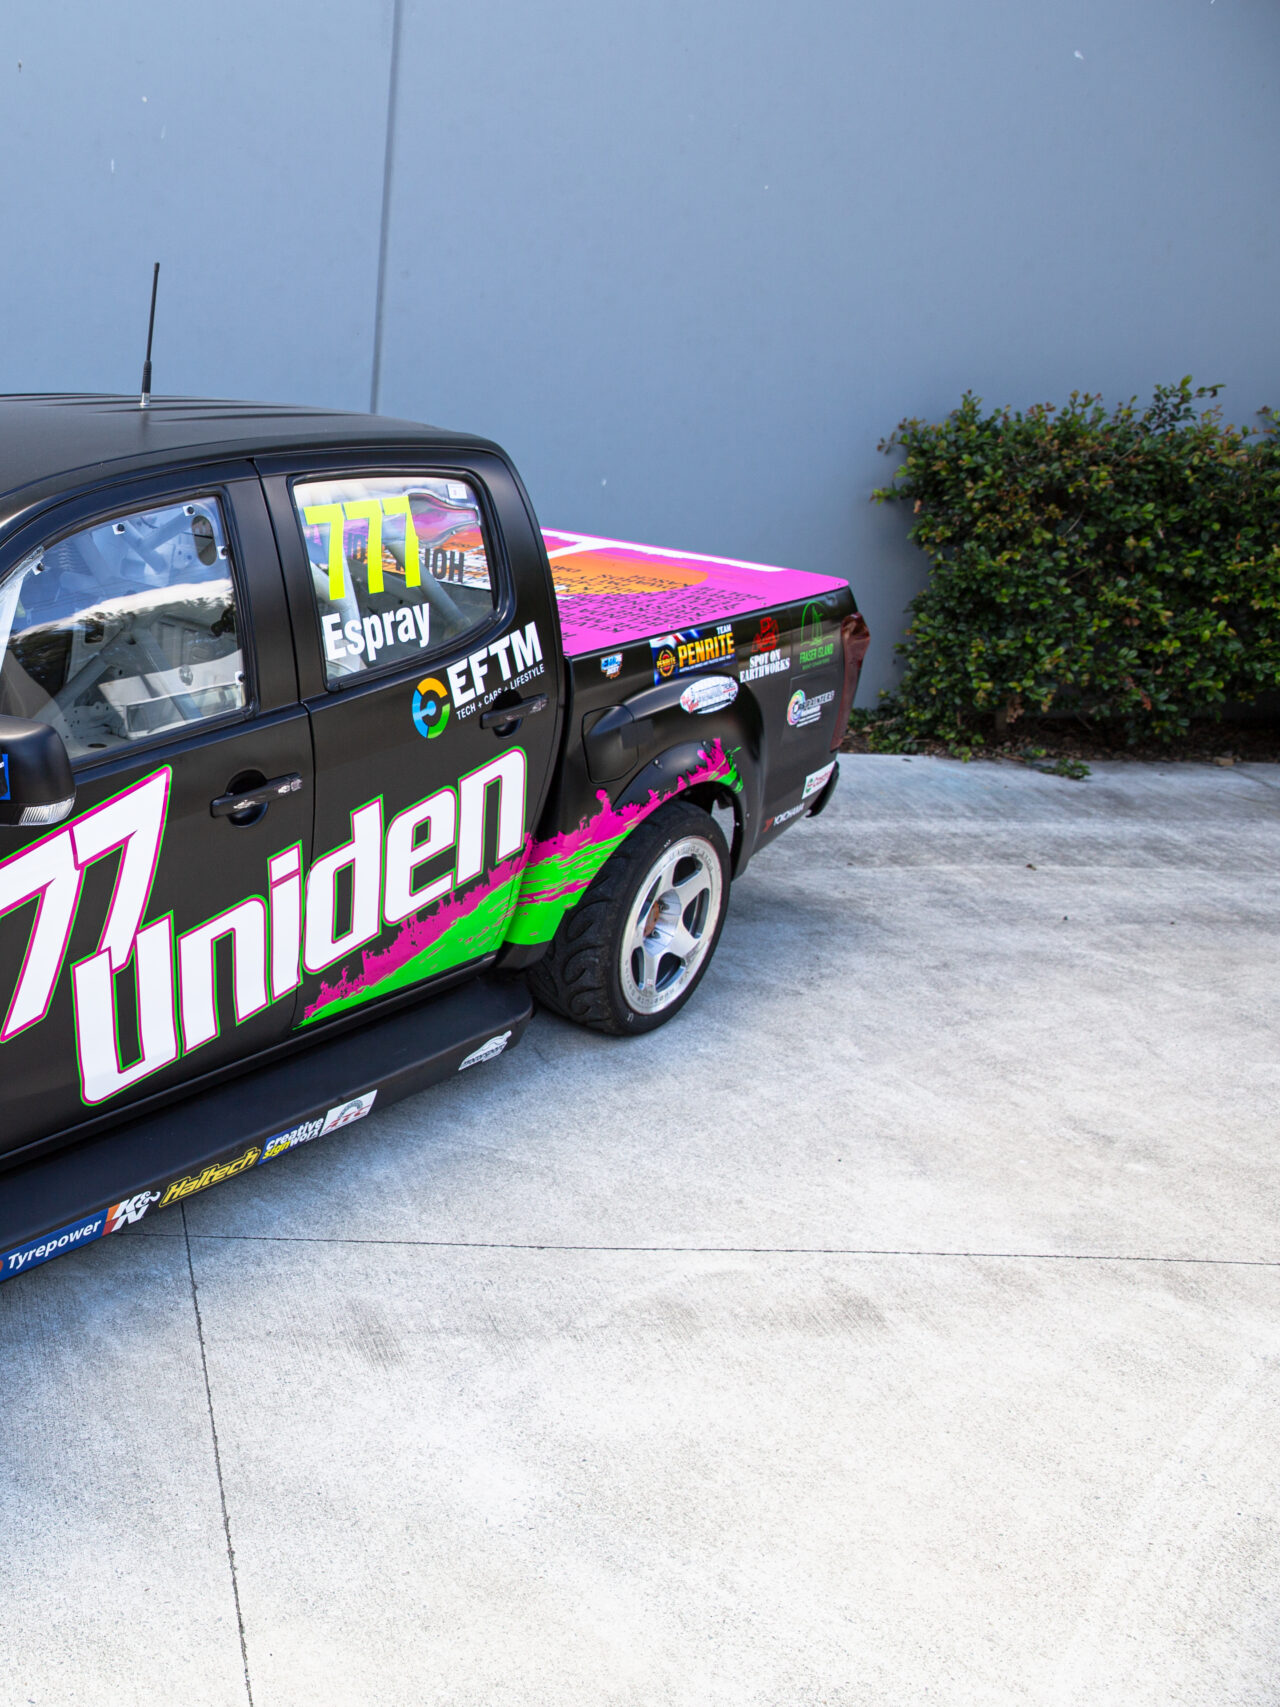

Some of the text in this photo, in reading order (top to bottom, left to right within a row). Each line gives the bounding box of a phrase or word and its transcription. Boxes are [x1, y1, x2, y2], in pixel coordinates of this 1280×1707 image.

[303, 495, 422, 601] 777
[321, 602, 430, 662] Espray
[677, 632, 735, 668] PENRITE
[716, 624, 732, 635] TEAM
[446, 621, 543, 708] EFTM
[740, 657, 790, 684] EARTHWORKS
[750, 652, 770, 668] SPOT
[770, 648, 781, 662] ON
[456, 703, 476, 720] TECH
[510, 663, 545, 690] LIFESTYLE
[71, 745, 528, 1106] Uniden
[266, 1117, 324, 1150] creative
[161, 1148, 260, 1206] Haltech
[8, 1220, 102, 1270] Tyrepower
